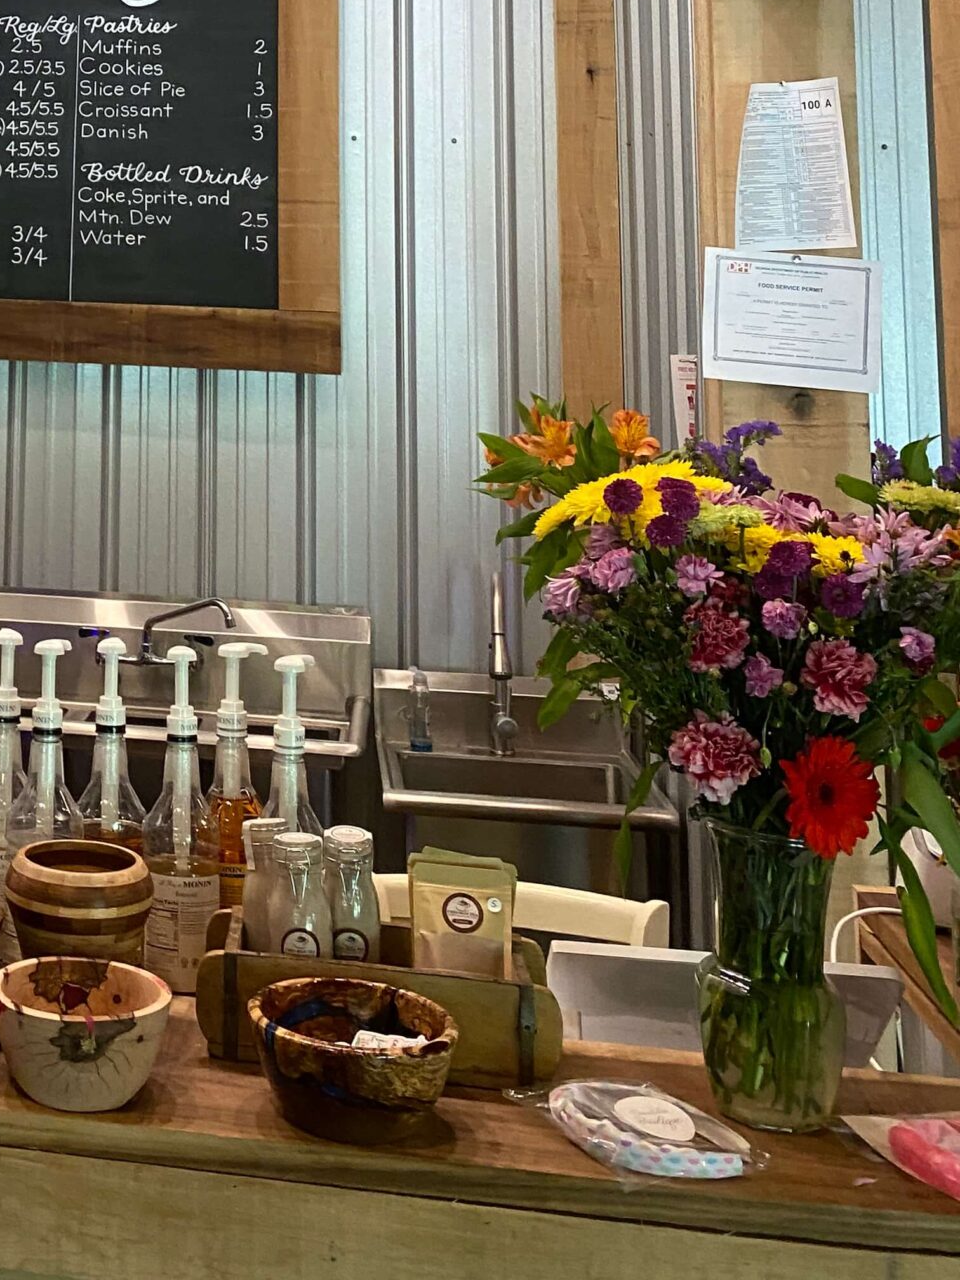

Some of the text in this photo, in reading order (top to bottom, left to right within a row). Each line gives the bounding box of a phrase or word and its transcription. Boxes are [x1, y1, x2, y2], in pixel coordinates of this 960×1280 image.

[83, 14, 178, 34] Pastries
[10, 37, 42, 54] 2.5
[82, 38, 268, 56] Muffins 2
[8, 59, 66, 76] 2.5/3.5
[79, 56, 164, 76] Cookies
[79, 79, 265, 97] Slice of Pie 3
[5, 100, 65, 117] 4.5/5.5
[78, 100, 273, 119] Croissant 1.5
[801, 99, 832, 110] 100 A
[5, 119, 59, 136] 4.5/5.5
[80, 122, 264, 141] Danish 3
[5, 140, 61, 157] 4.5/5.5
[4, 161, 59, 179] 4.5/5.5
[80, 161, 269, 190] Bottled Drinks
[77, 186, 230, 211] Coke, Sprite, and
[79, 209, 270, 229] Mtn. Dew 2.5
[11, 224, 48, 244] 3/4
[79, 229, 269, 252] Water 1.5
[10, 246, 48, 268] 3/4
[758, 282, 824, 293] FOOD SERVICE PERMIT
[183, 880, 212, 889] MONIN
